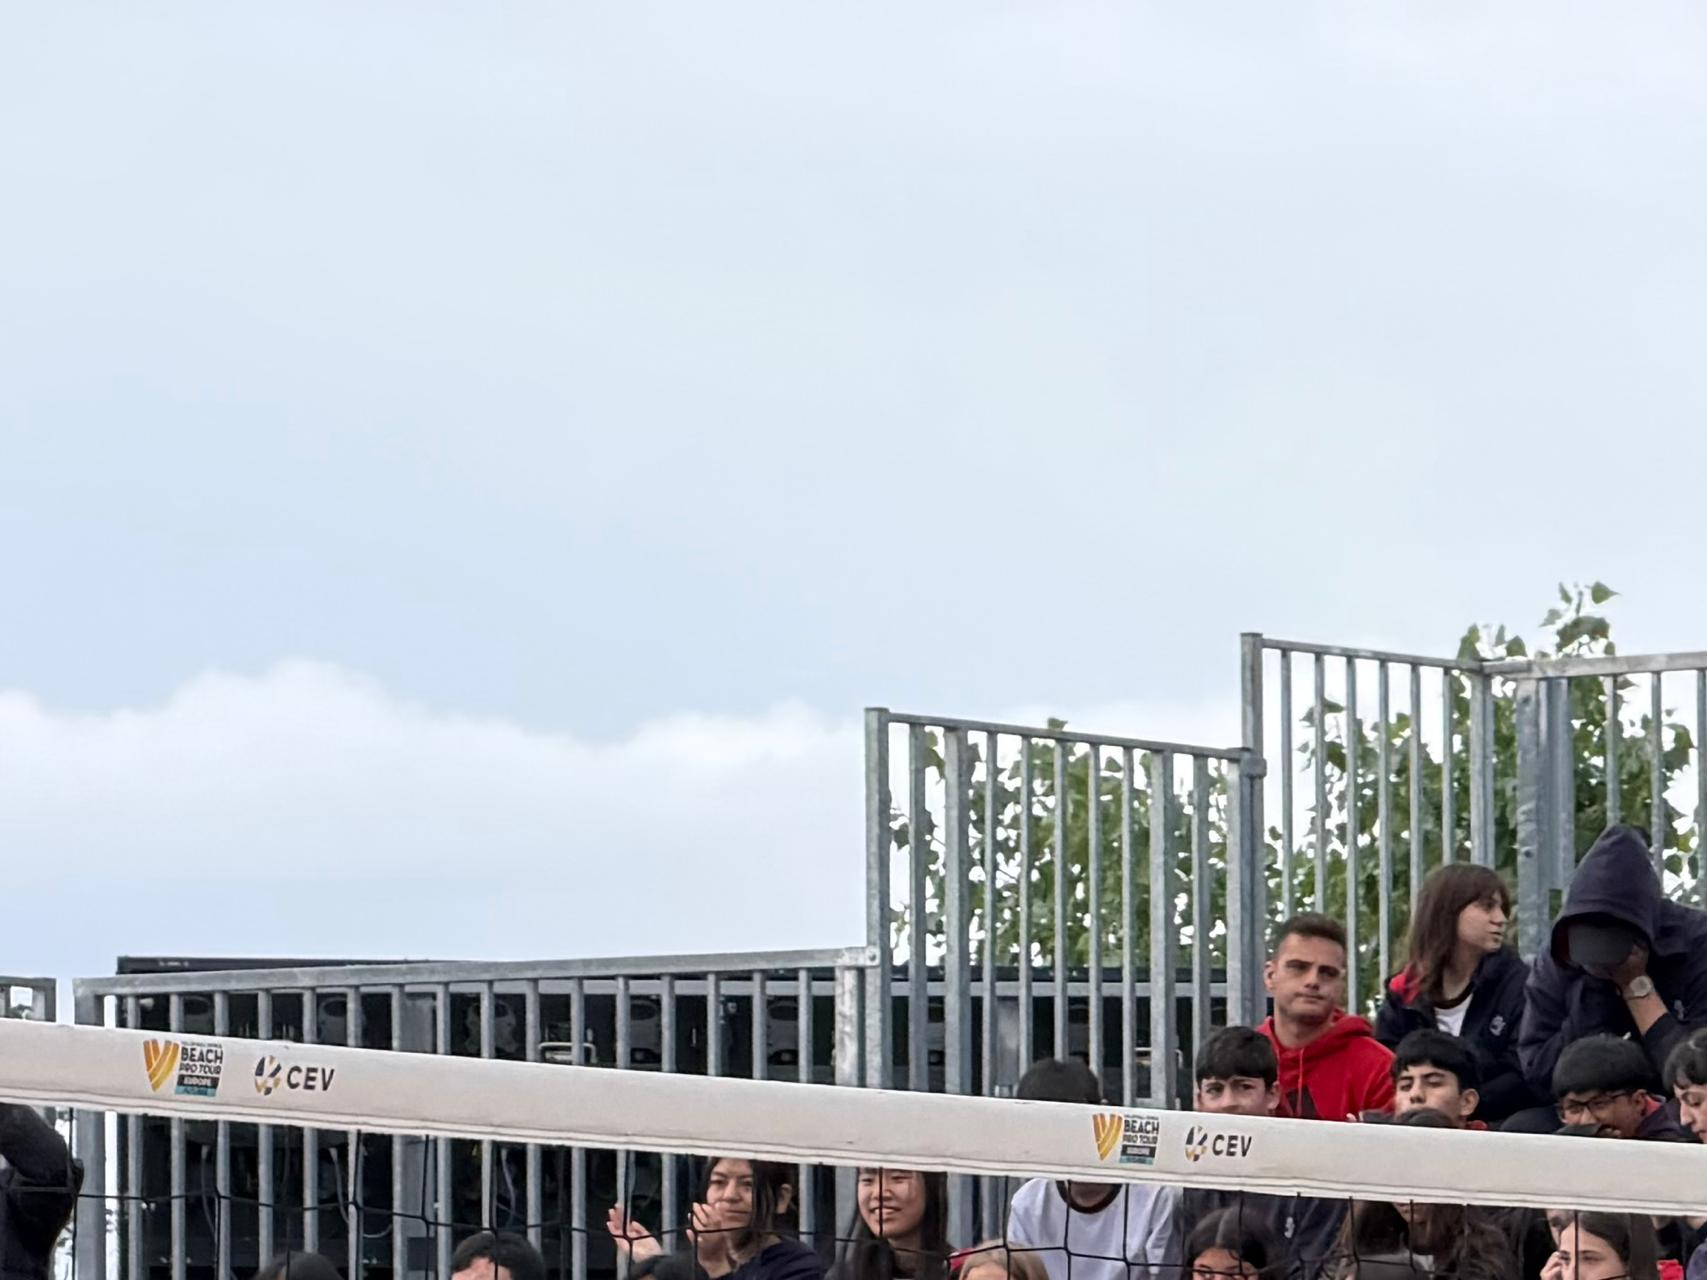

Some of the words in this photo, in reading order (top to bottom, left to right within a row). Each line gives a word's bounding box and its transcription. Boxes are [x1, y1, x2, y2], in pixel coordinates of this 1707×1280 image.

[181, 1047, 223, 1065] BEACH
[287, 1065, 334, 1092] CEV
[1124, 1119, 1160, 1134] BEACH
[1212, 1134, 1252, 1157] CEV
